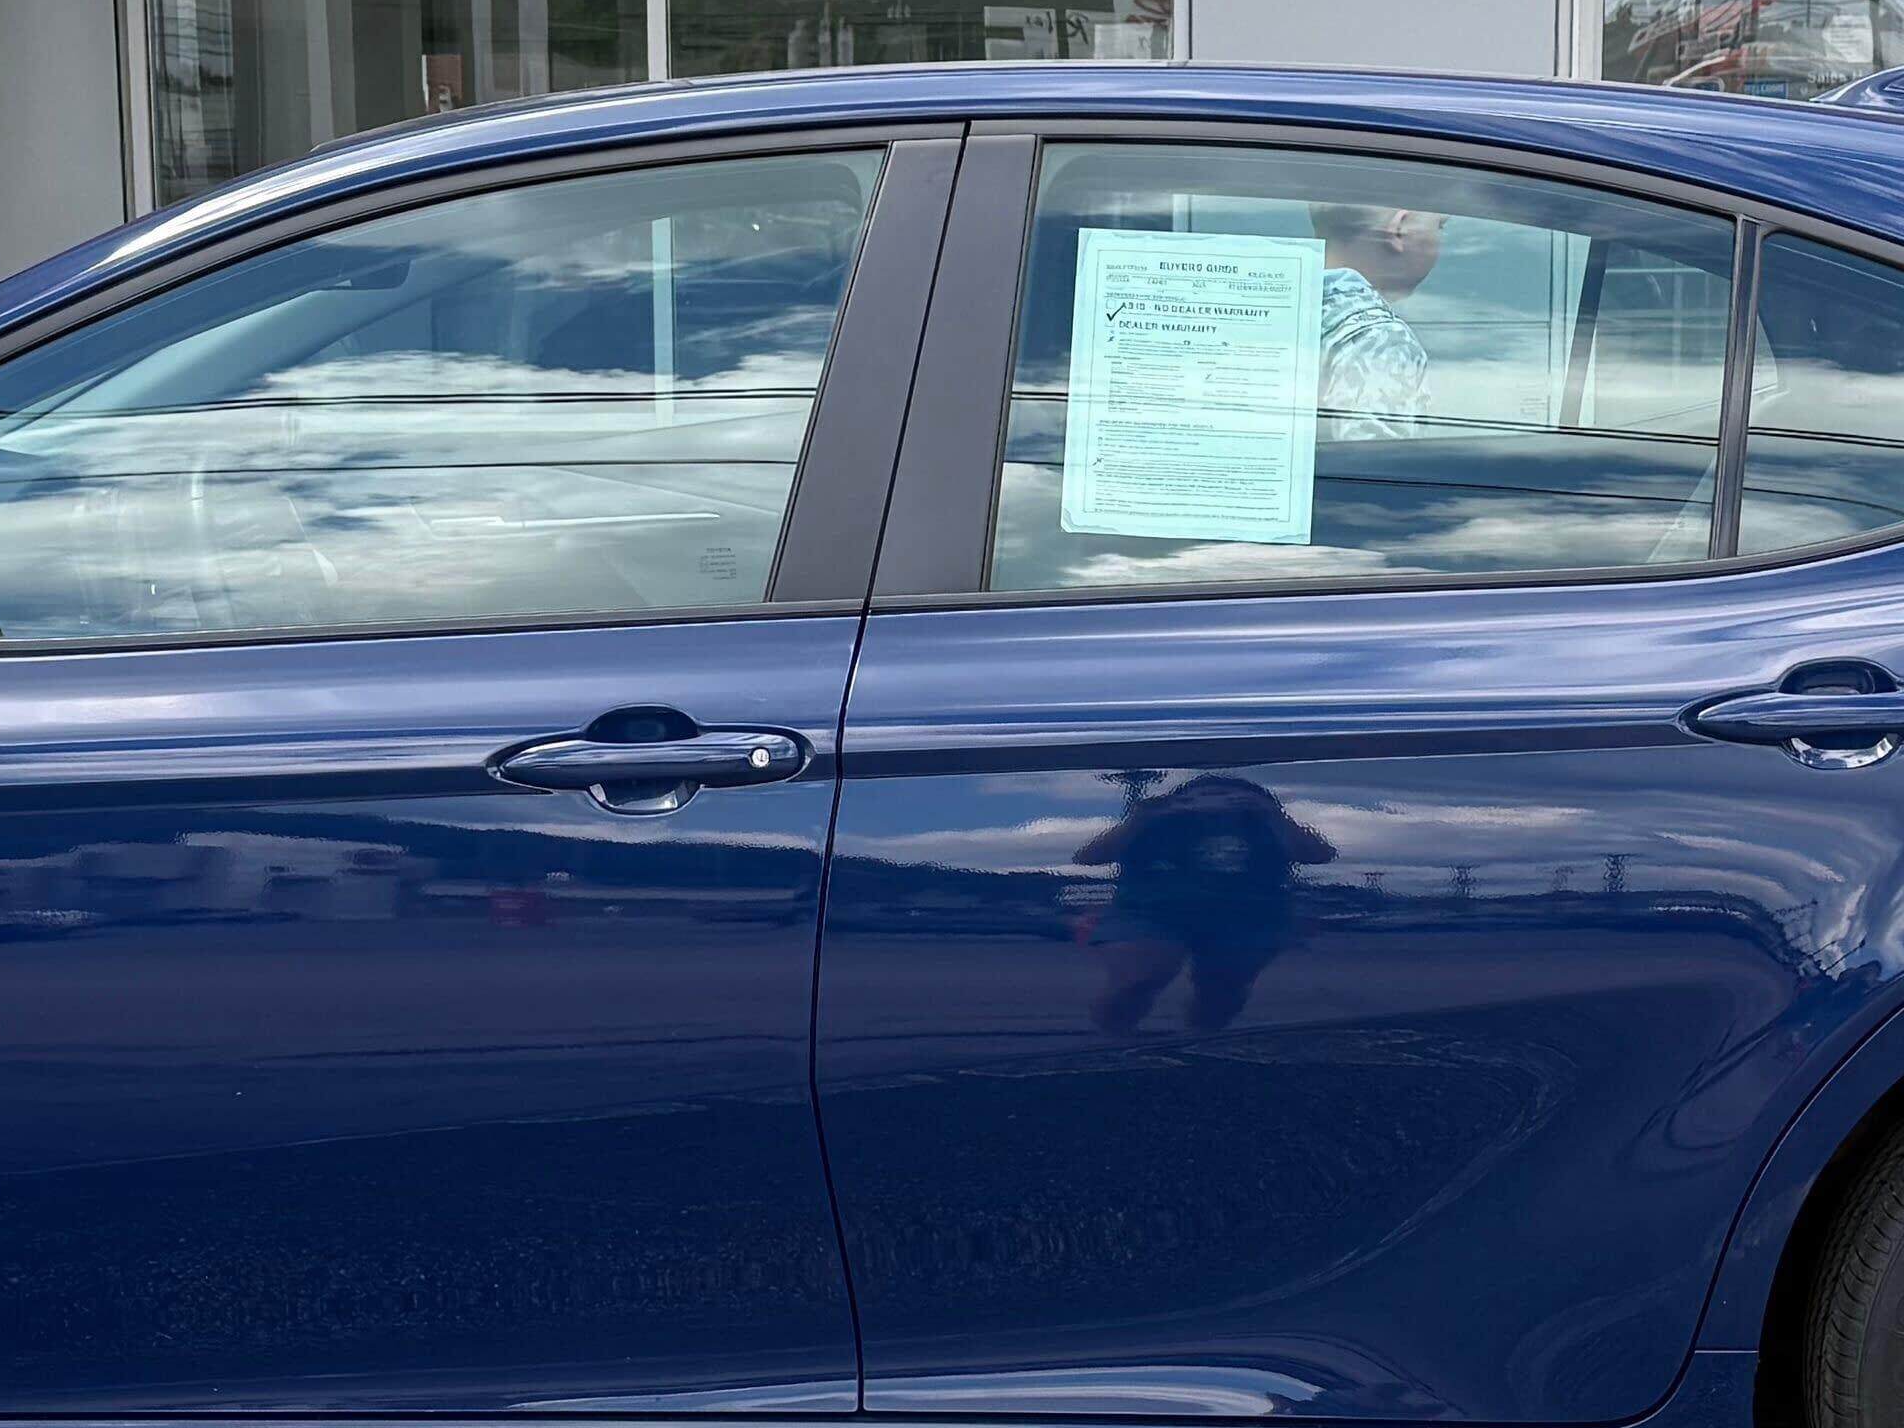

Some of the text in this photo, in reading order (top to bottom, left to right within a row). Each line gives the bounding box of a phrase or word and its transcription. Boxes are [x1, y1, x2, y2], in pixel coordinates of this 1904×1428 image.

[1171, 305, 1212, 315] DEALER
[1214, 307, 1271, 318] WARRANTY
[1119, 320, 1158, 331] DEALER
[1161, 323, 1217, 334] WARRANTY
